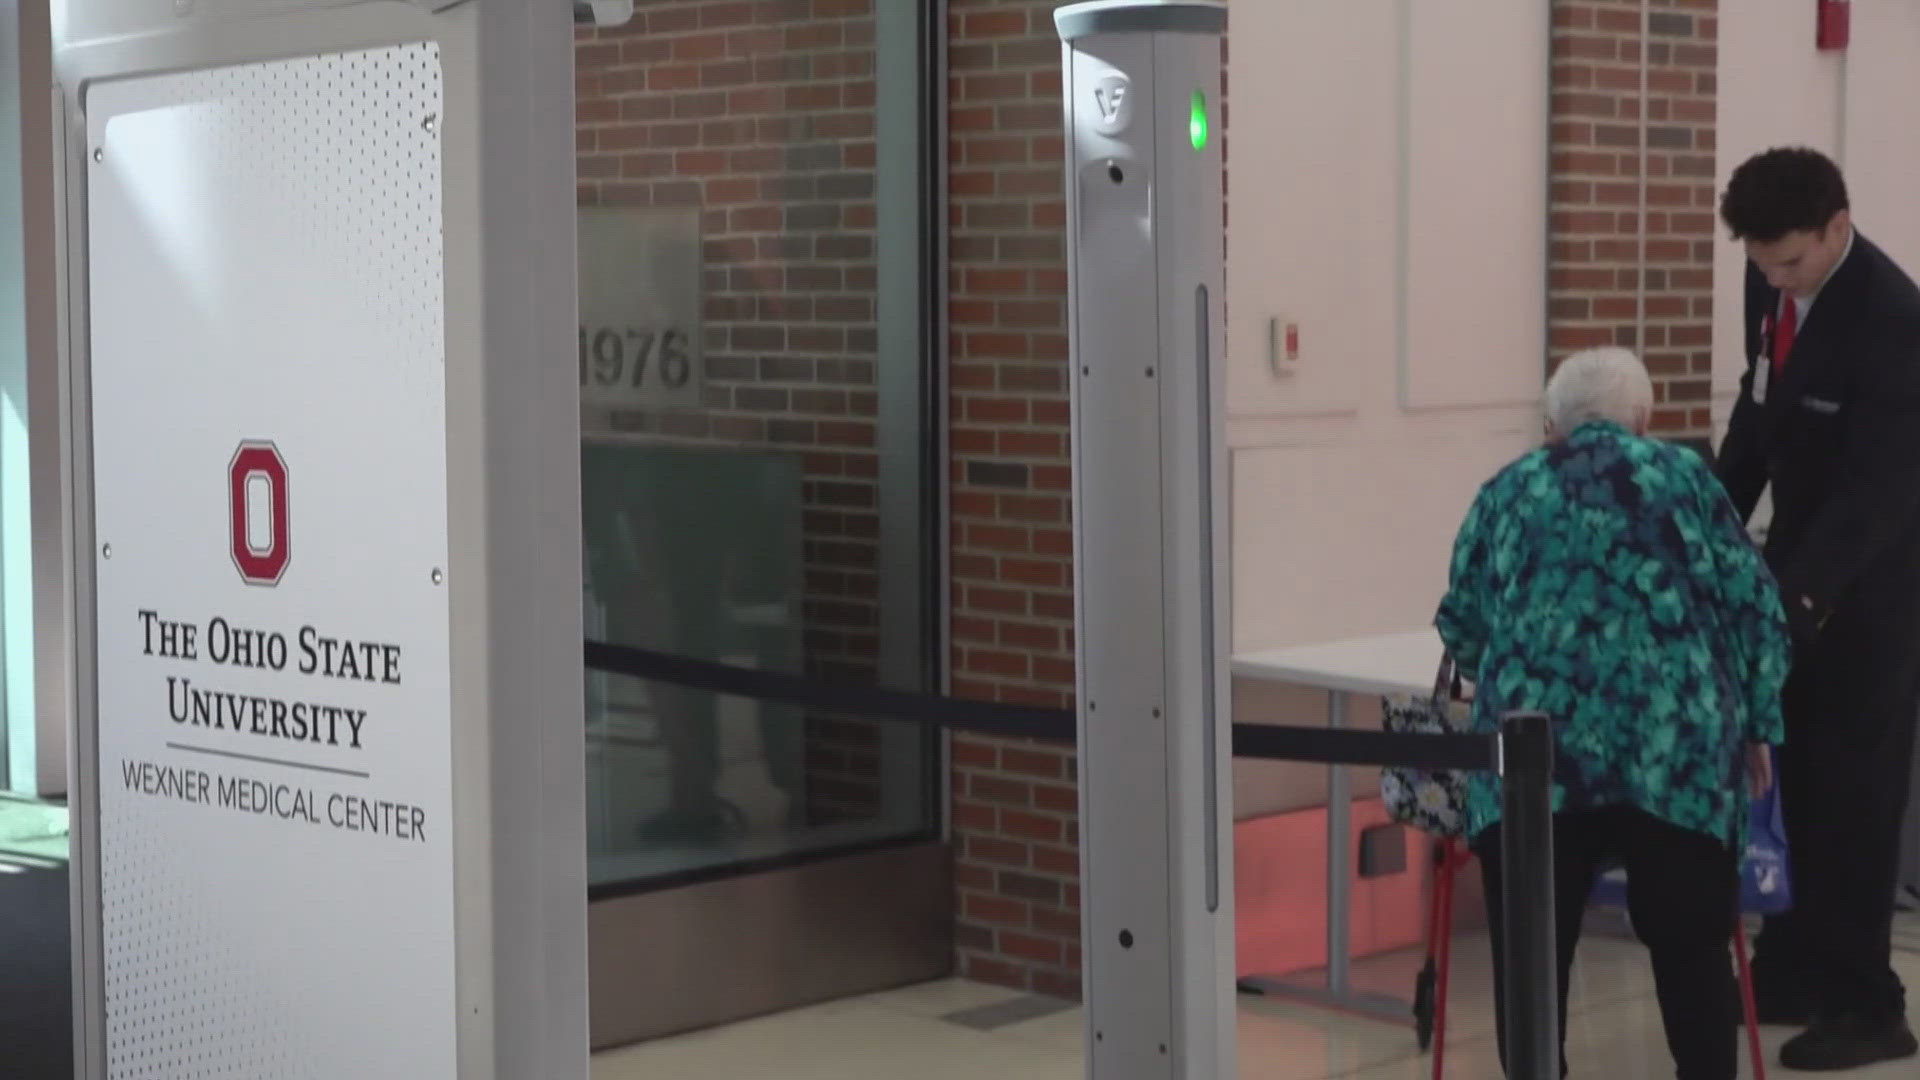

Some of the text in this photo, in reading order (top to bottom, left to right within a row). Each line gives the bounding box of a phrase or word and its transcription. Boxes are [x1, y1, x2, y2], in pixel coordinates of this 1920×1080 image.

[579, 325, 690, 388] 1976
[228, 439, 290, 588] O
[138, 609, 401, 685] THE OHIO STATE
[166, 676, 367, 749] UNIVERSITY
[122, 759, 426, 842] WEXNER MEDICAL CENTER
